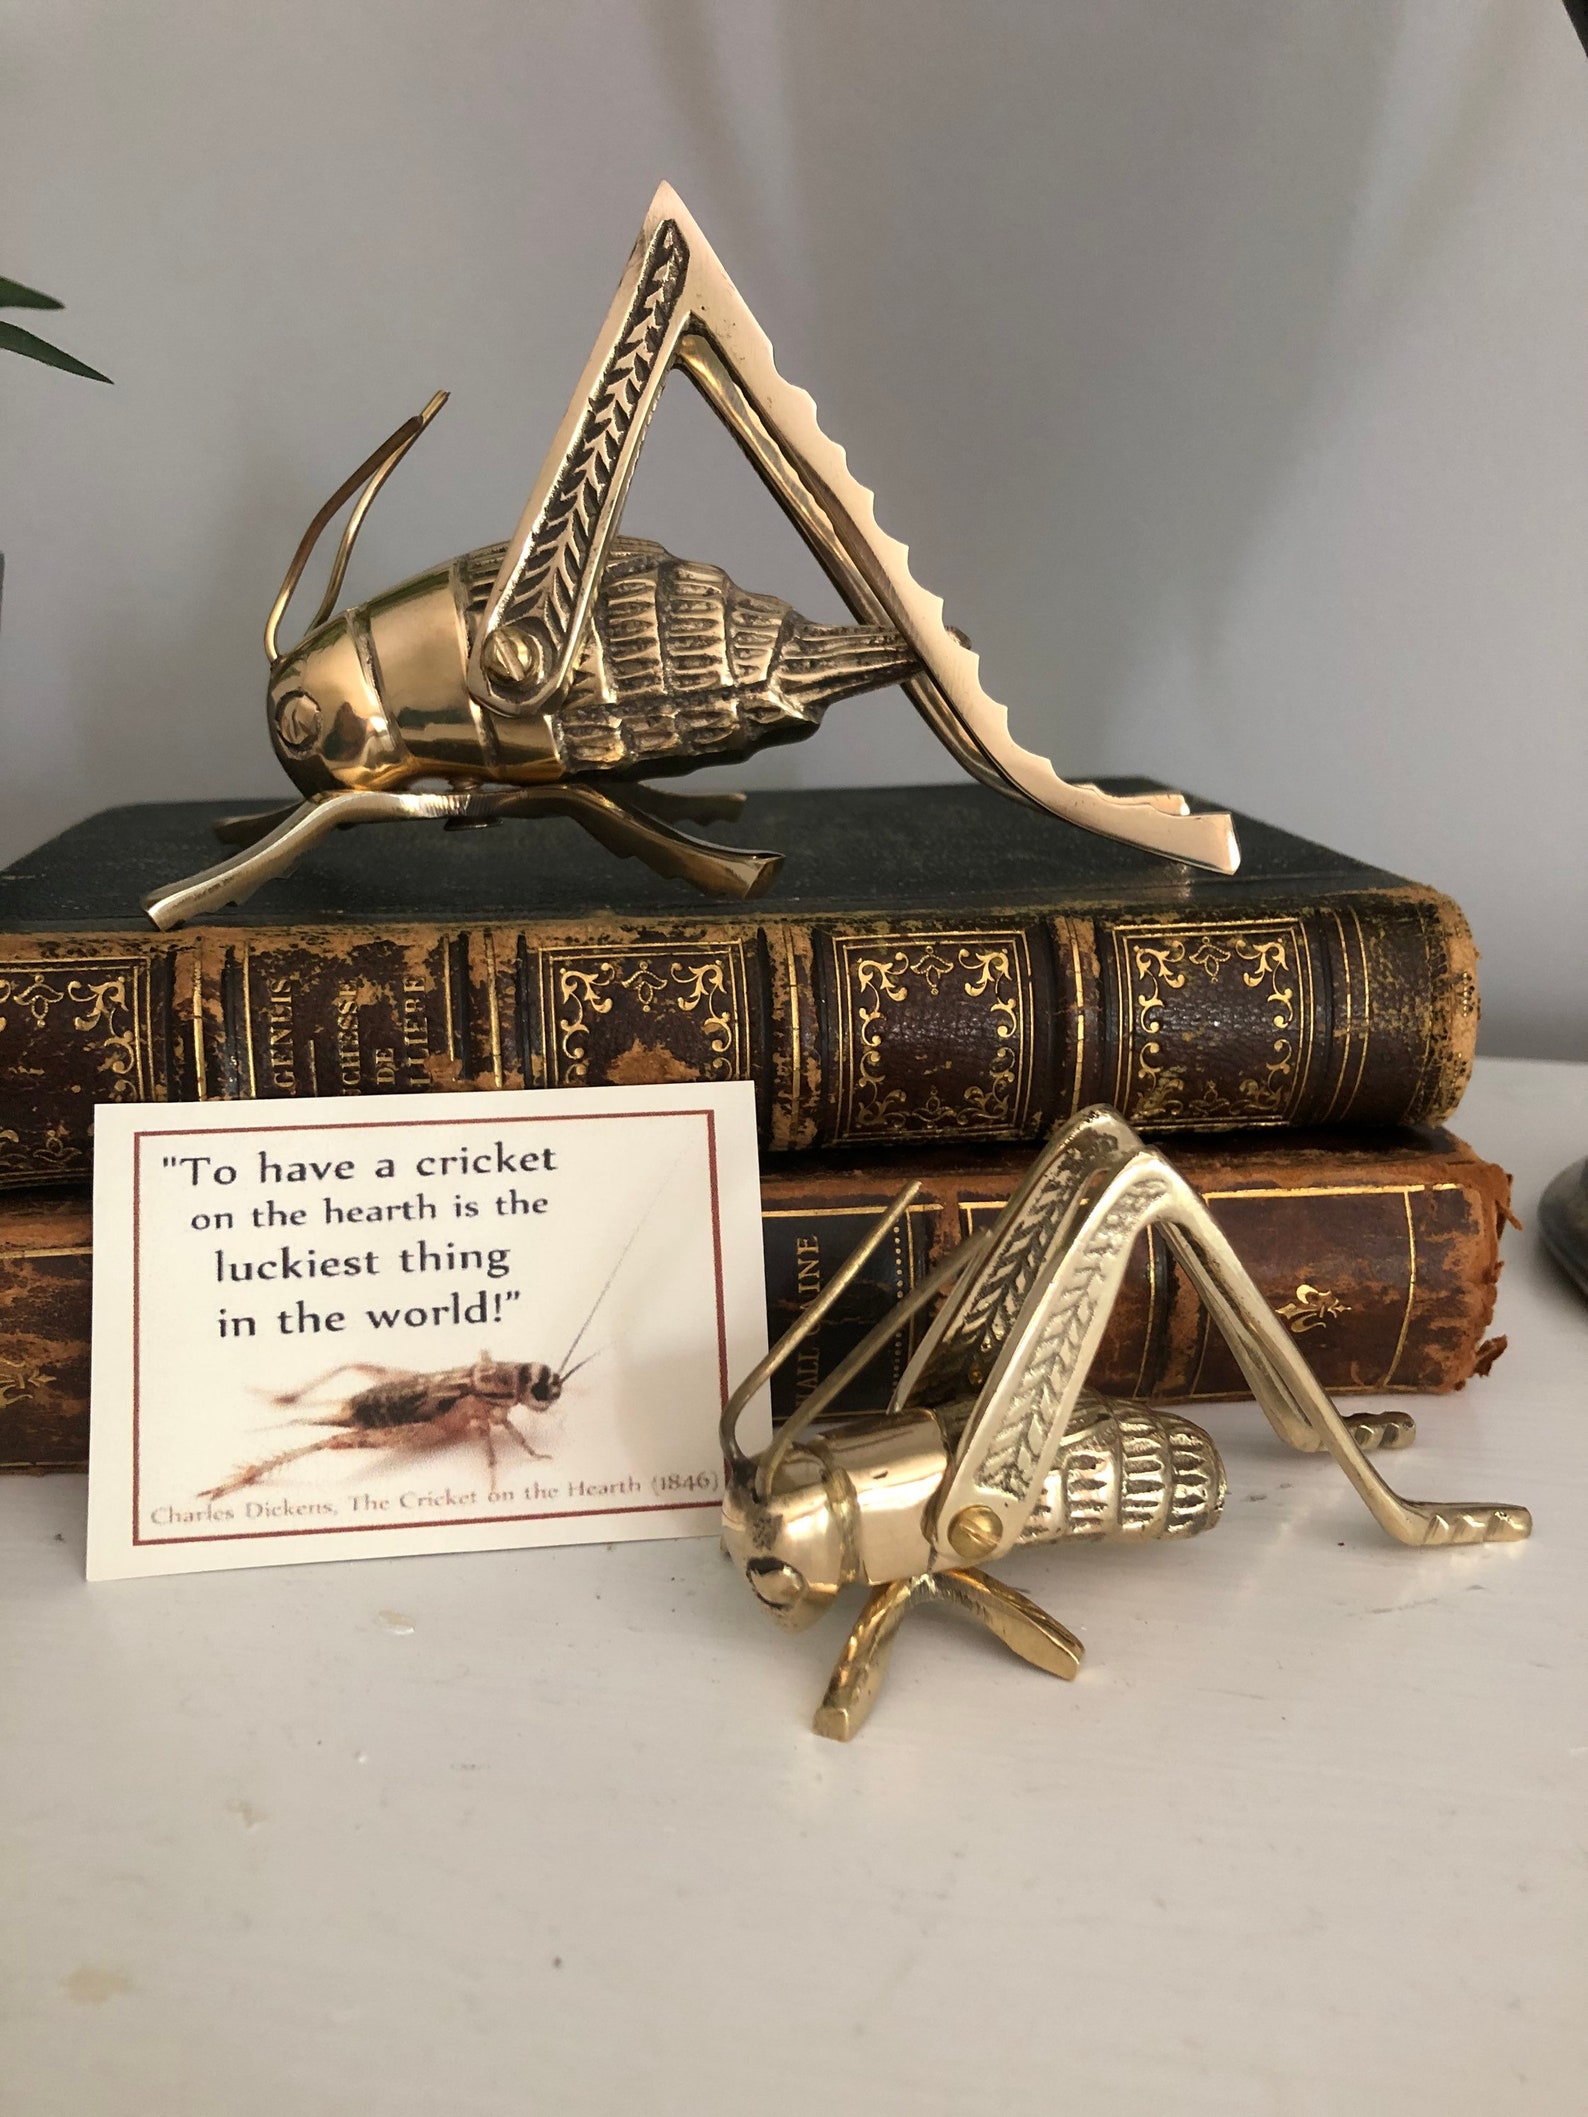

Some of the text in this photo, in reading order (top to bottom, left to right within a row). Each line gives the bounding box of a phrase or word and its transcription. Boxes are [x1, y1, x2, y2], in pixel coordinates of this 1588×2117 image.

[270, 978, 297, 1088] GENLIS
[375, 1047, 397, 1086] DE
[162, 1140, 559, 1187] "To have a cricket
[191, 1188, 549, 1231] on the hearth is the
[214, 1239, 511, 1283] luckiest thing
[217, 1289, 521, 1338] in the world!”
[150, 1470, 720, 1526] Charles Dickens, The Cricket on the Hearth (1846)
